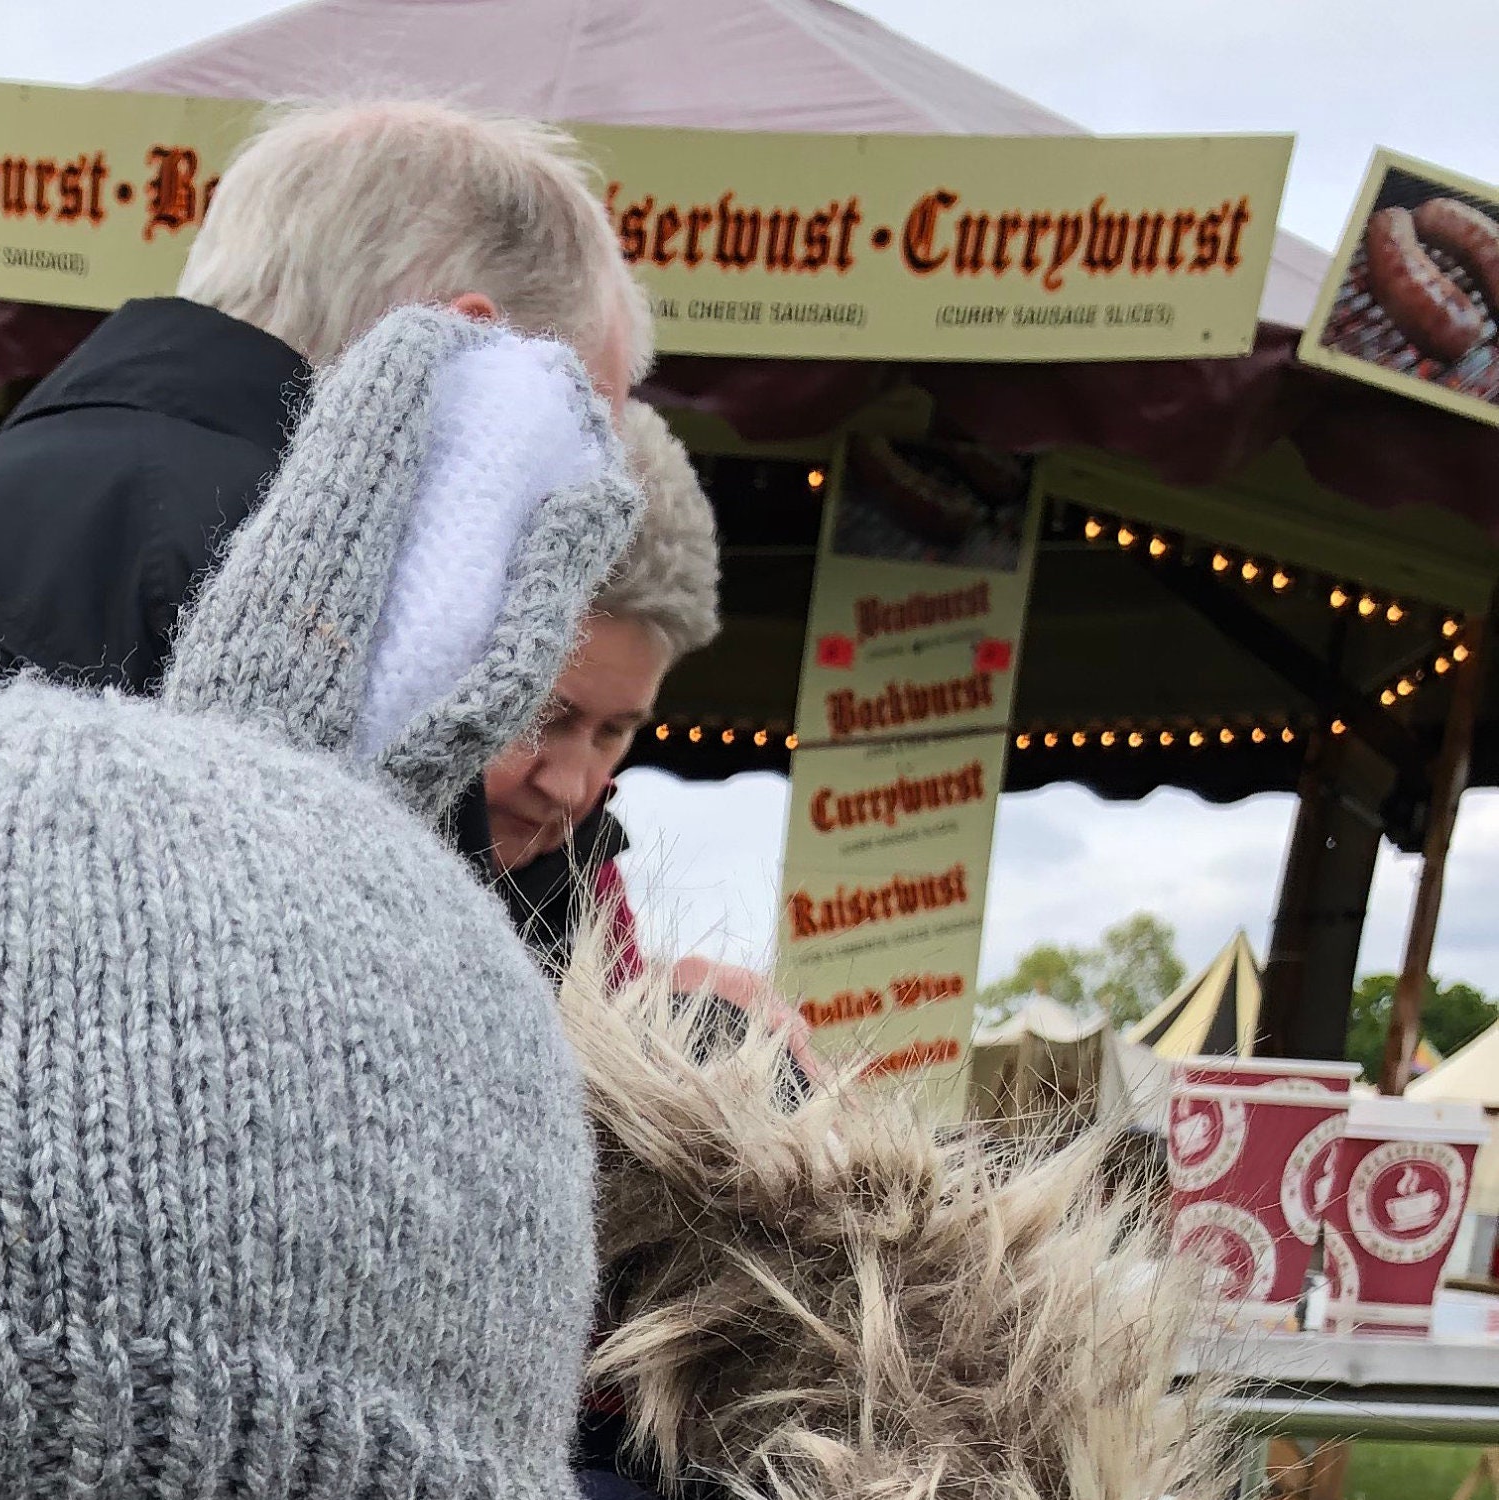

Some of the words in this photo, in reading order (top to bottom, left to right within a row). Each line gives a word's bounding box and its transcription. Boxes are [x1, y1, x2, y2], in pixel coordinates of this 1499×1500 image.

[902, 187, 1250, 291] Currywurst
[687, 299, 763, 323] CHEESE
[935, 303, 1006, 328] (CURRY
[1011, 303, 1098, 328] SAUSAGE
[825, 671, 994, 740] Bockwurst
[810, 760, 985, 833] Currywurst
